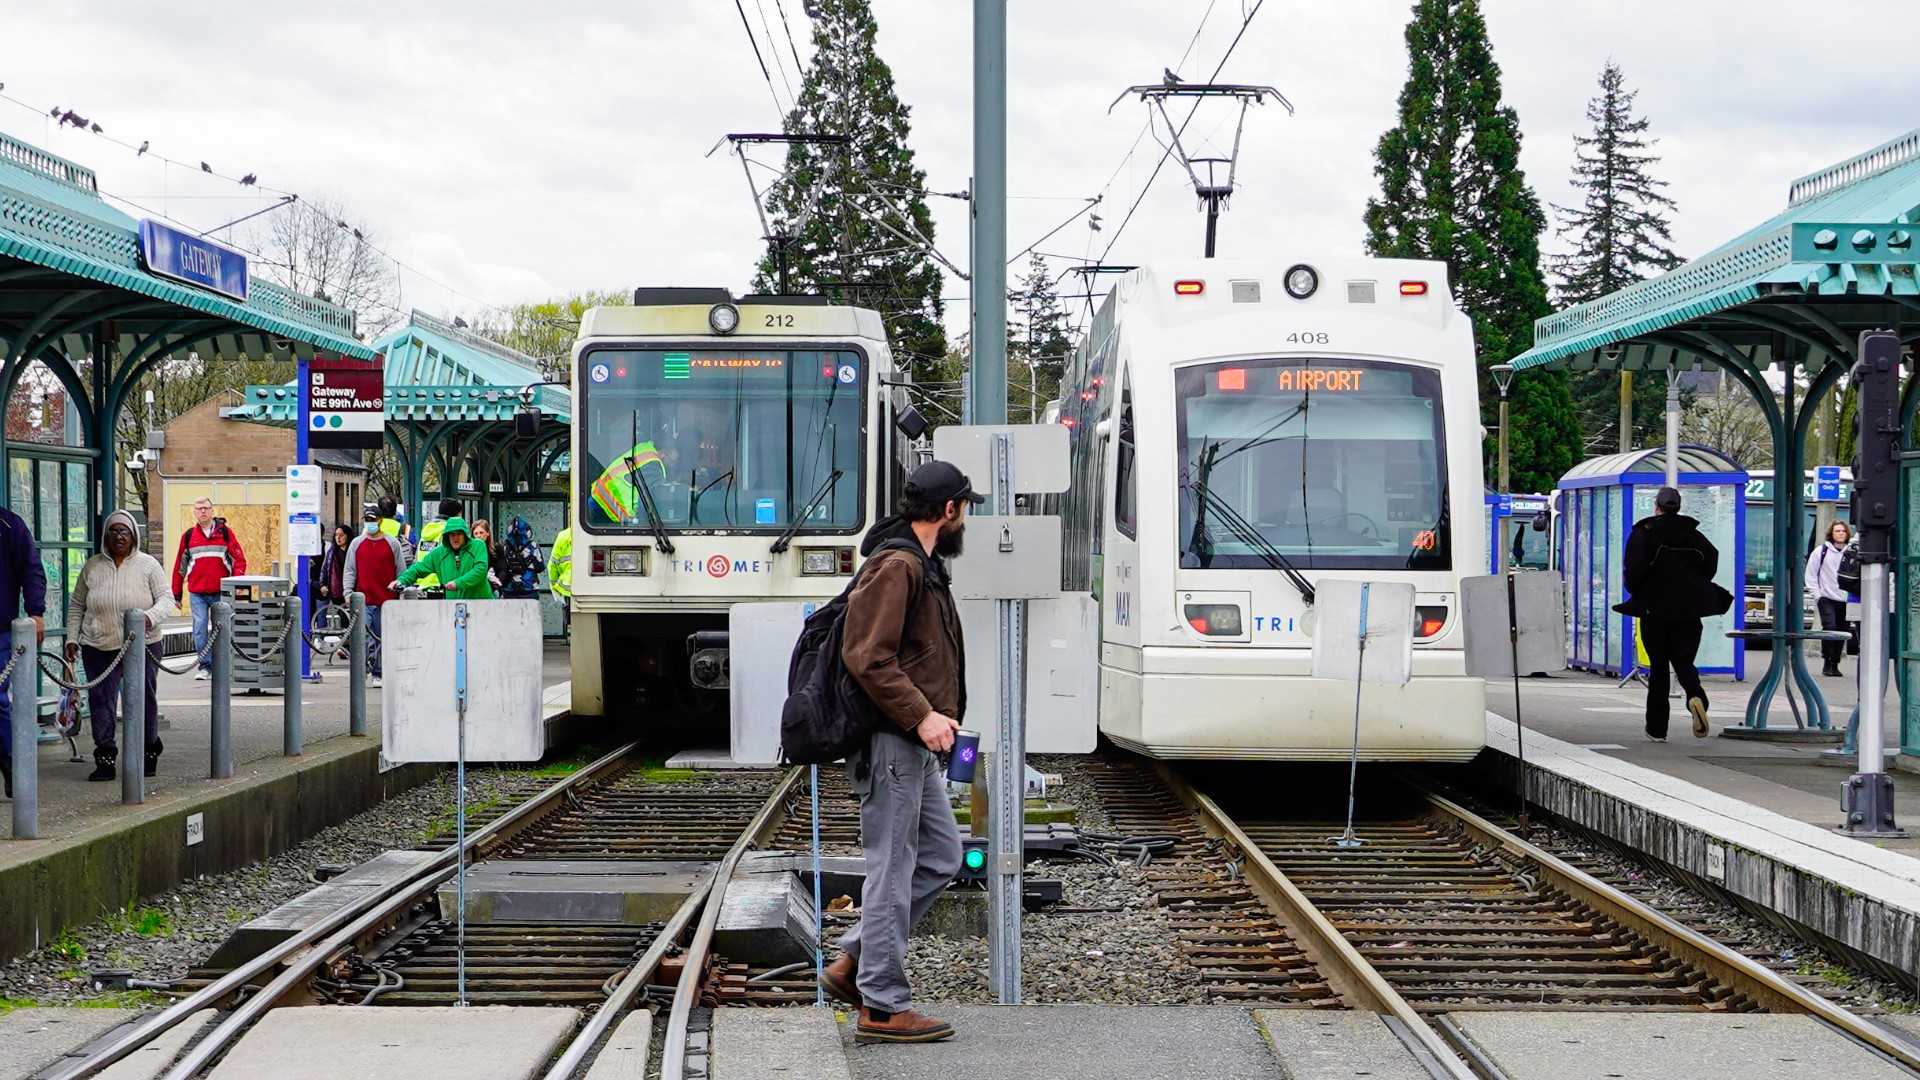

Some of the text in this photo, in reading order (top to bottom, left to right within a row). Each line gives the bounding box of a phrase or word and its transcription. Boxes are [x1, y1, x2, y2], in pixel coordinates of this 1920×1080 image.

[181, 241, 222, 281] GATEWAY
[765, 315, 794, 327] 212
[1286, 332, 1329, 344] 408
[1279, 370, 1363, 391] AIRPORT
[311, 386, 356, 398] Gateway
[311, 398, 327, 408] NE
[328, 398, 351, 408] 99th
[352, 398, 372, 408] Ave
[671, 561, 773, 572] TRI MET
[1115, 591, 1131, 627] MAX
[1254, 617, 1293, 631] TRI
